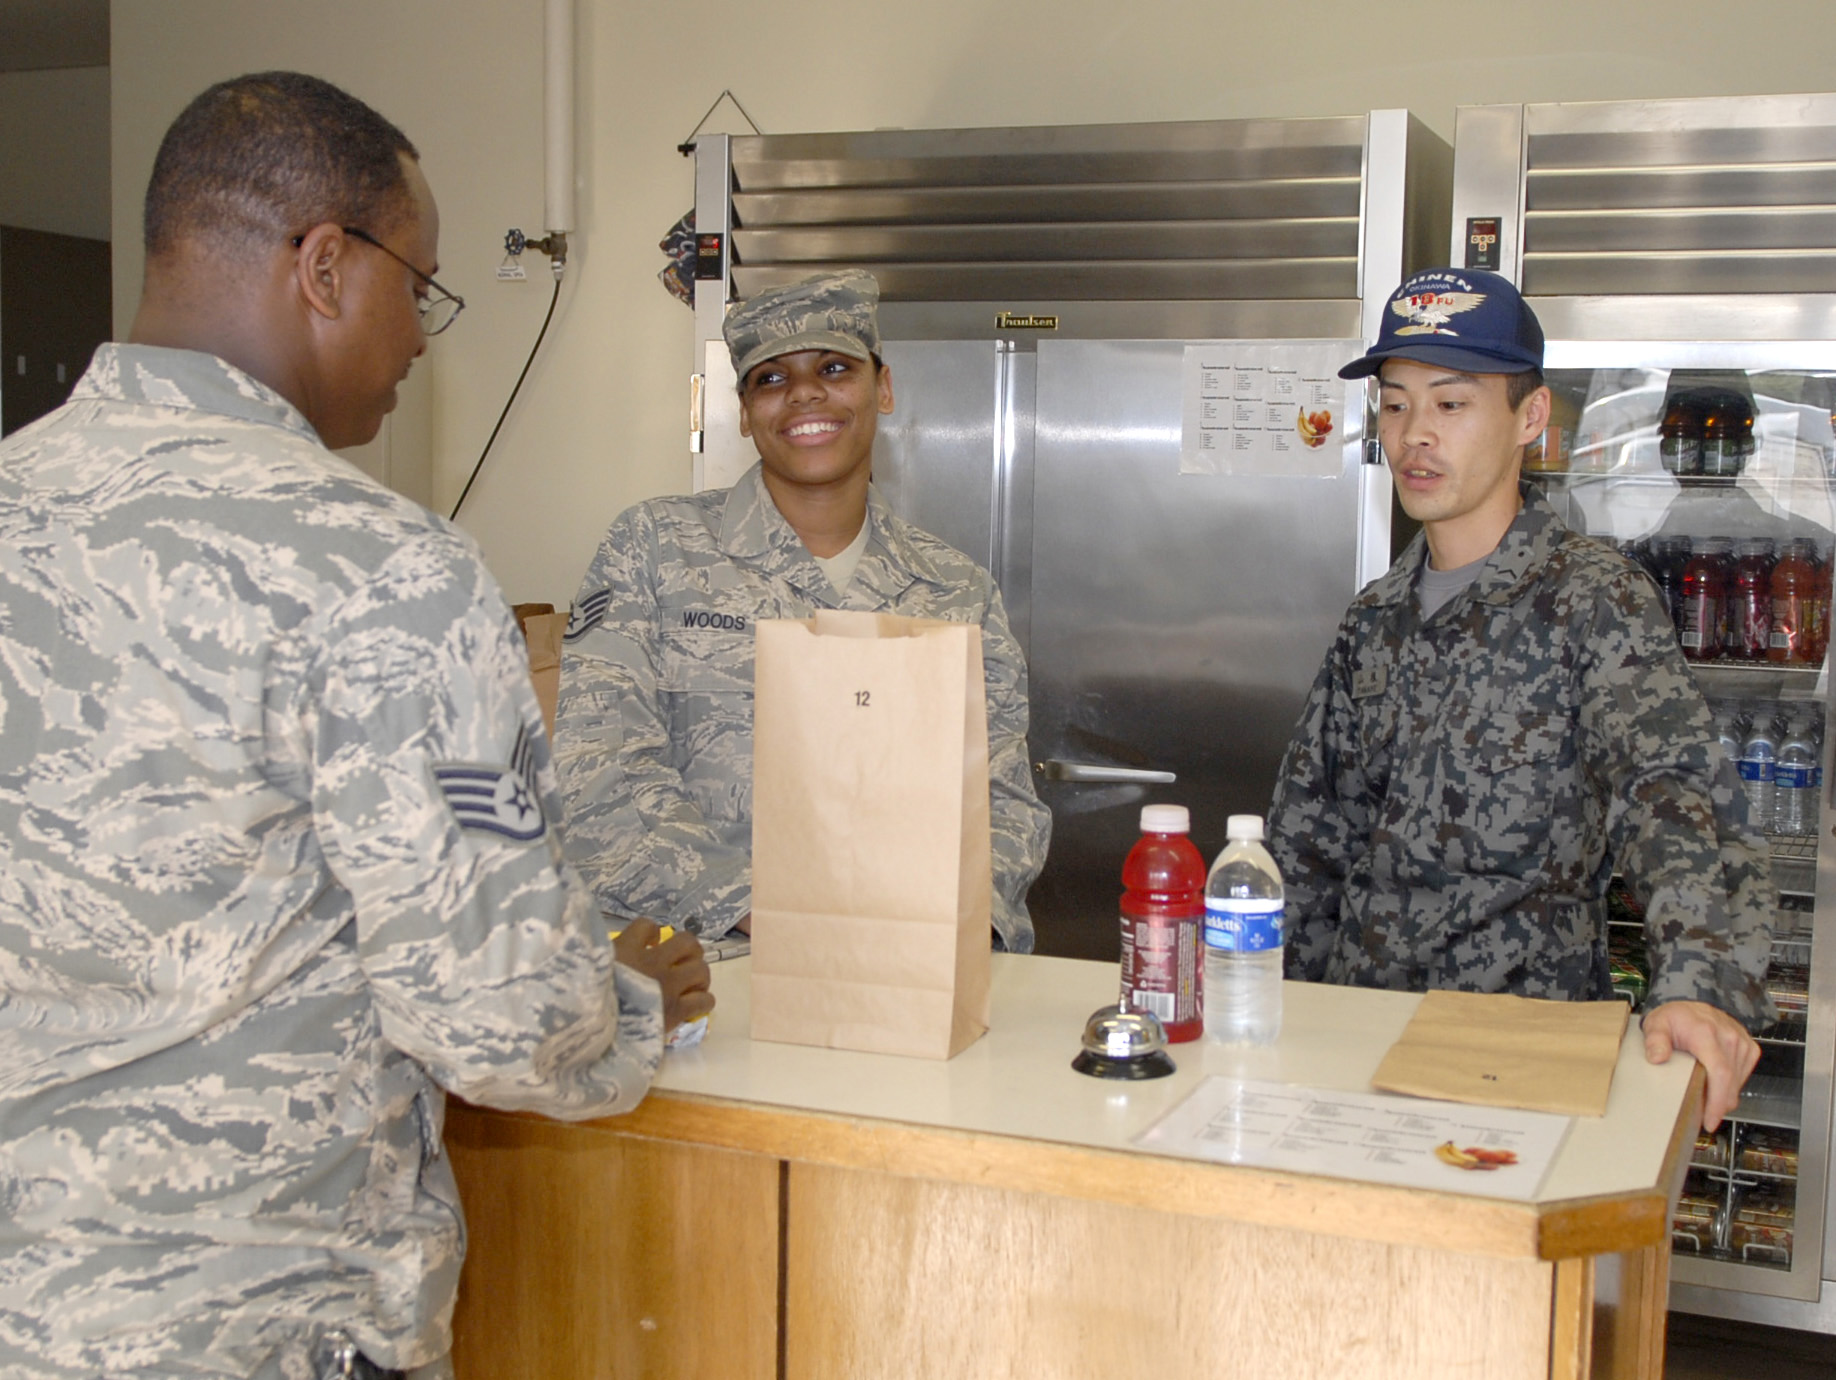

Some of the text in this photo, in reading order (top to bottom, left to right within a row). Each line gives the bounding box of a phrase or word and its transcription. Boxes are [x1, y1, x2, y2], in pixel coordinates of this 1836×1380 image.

[1409, 283, 1451, 292] OKINAWA
[683, 611, 746, 631] WOODS
[854, 690, 871, 707] 12
